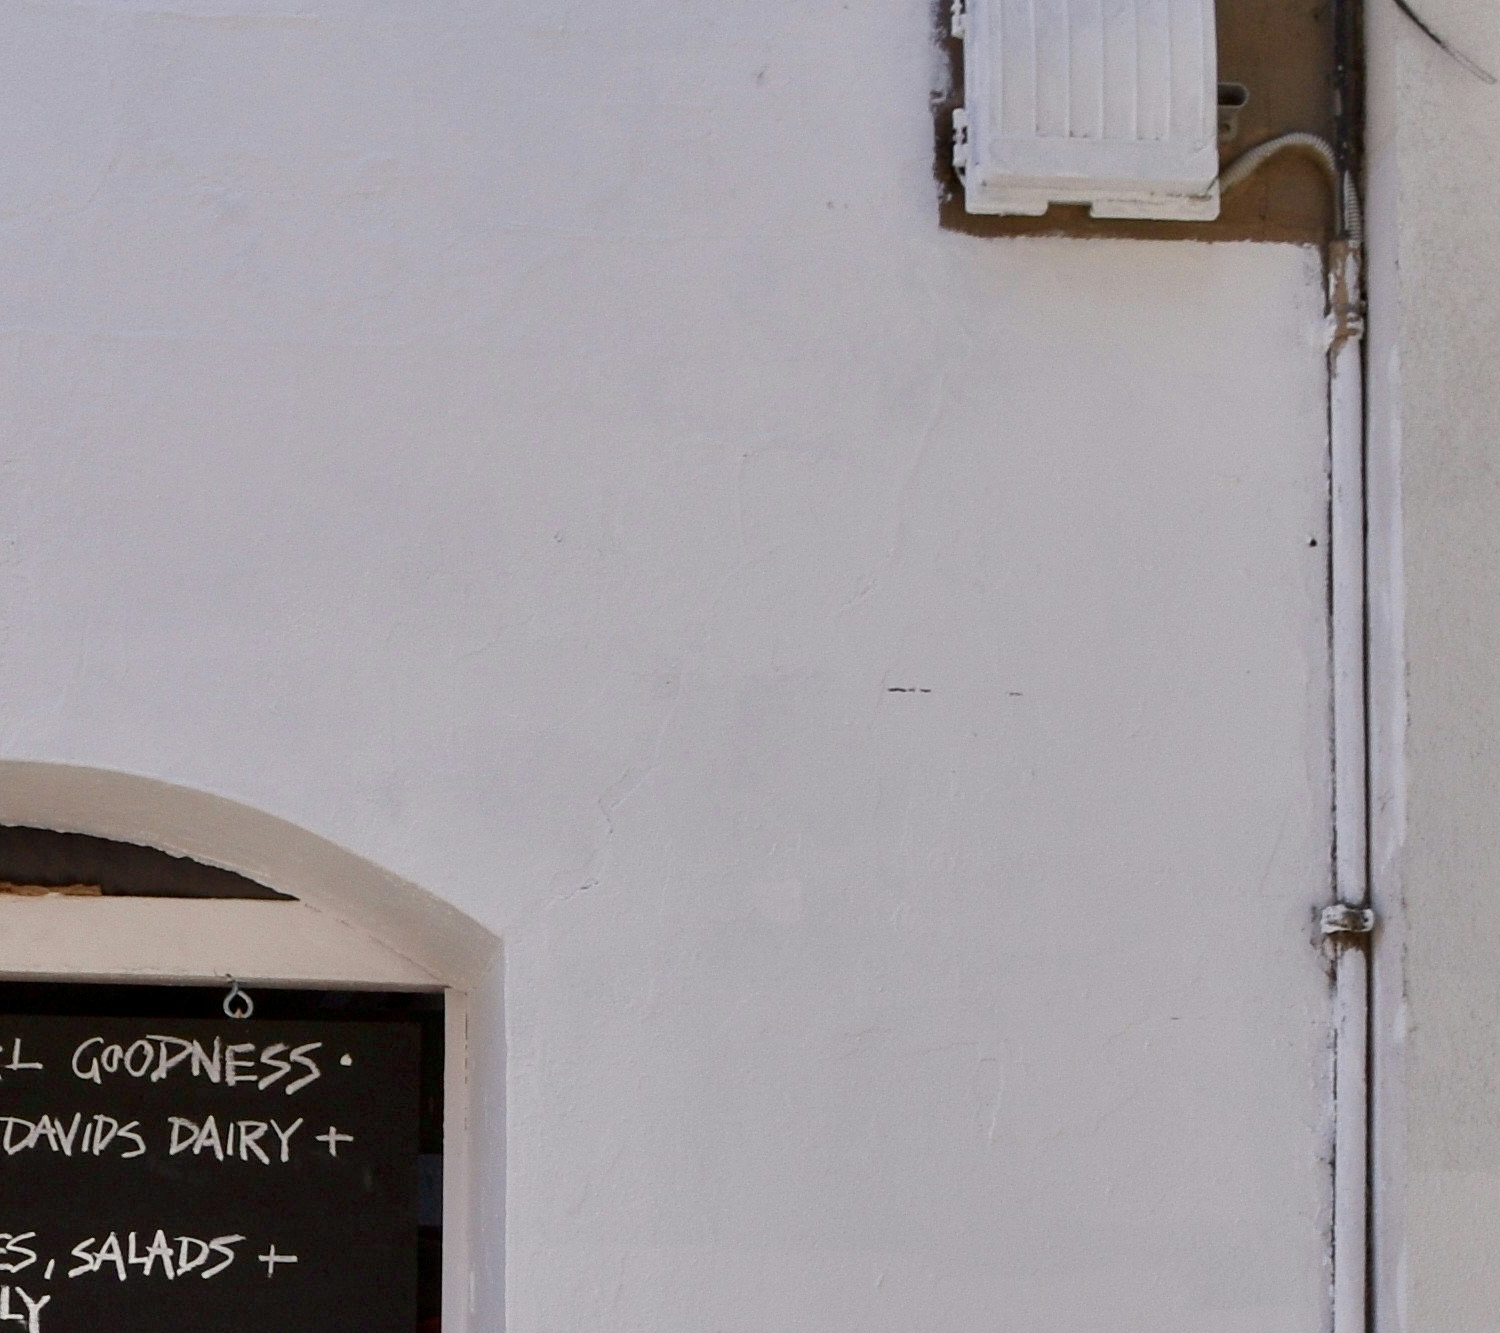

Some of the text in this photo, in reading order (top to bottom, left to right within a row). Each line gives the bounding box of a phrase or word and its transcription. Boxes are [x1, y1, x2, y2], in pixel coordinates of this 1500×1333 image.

[71, 1033, 323, 1096] GOODNESS
[167, 1114, 304, 1165] DAIRY
[67, 1229, 247, 1282] SALADS
